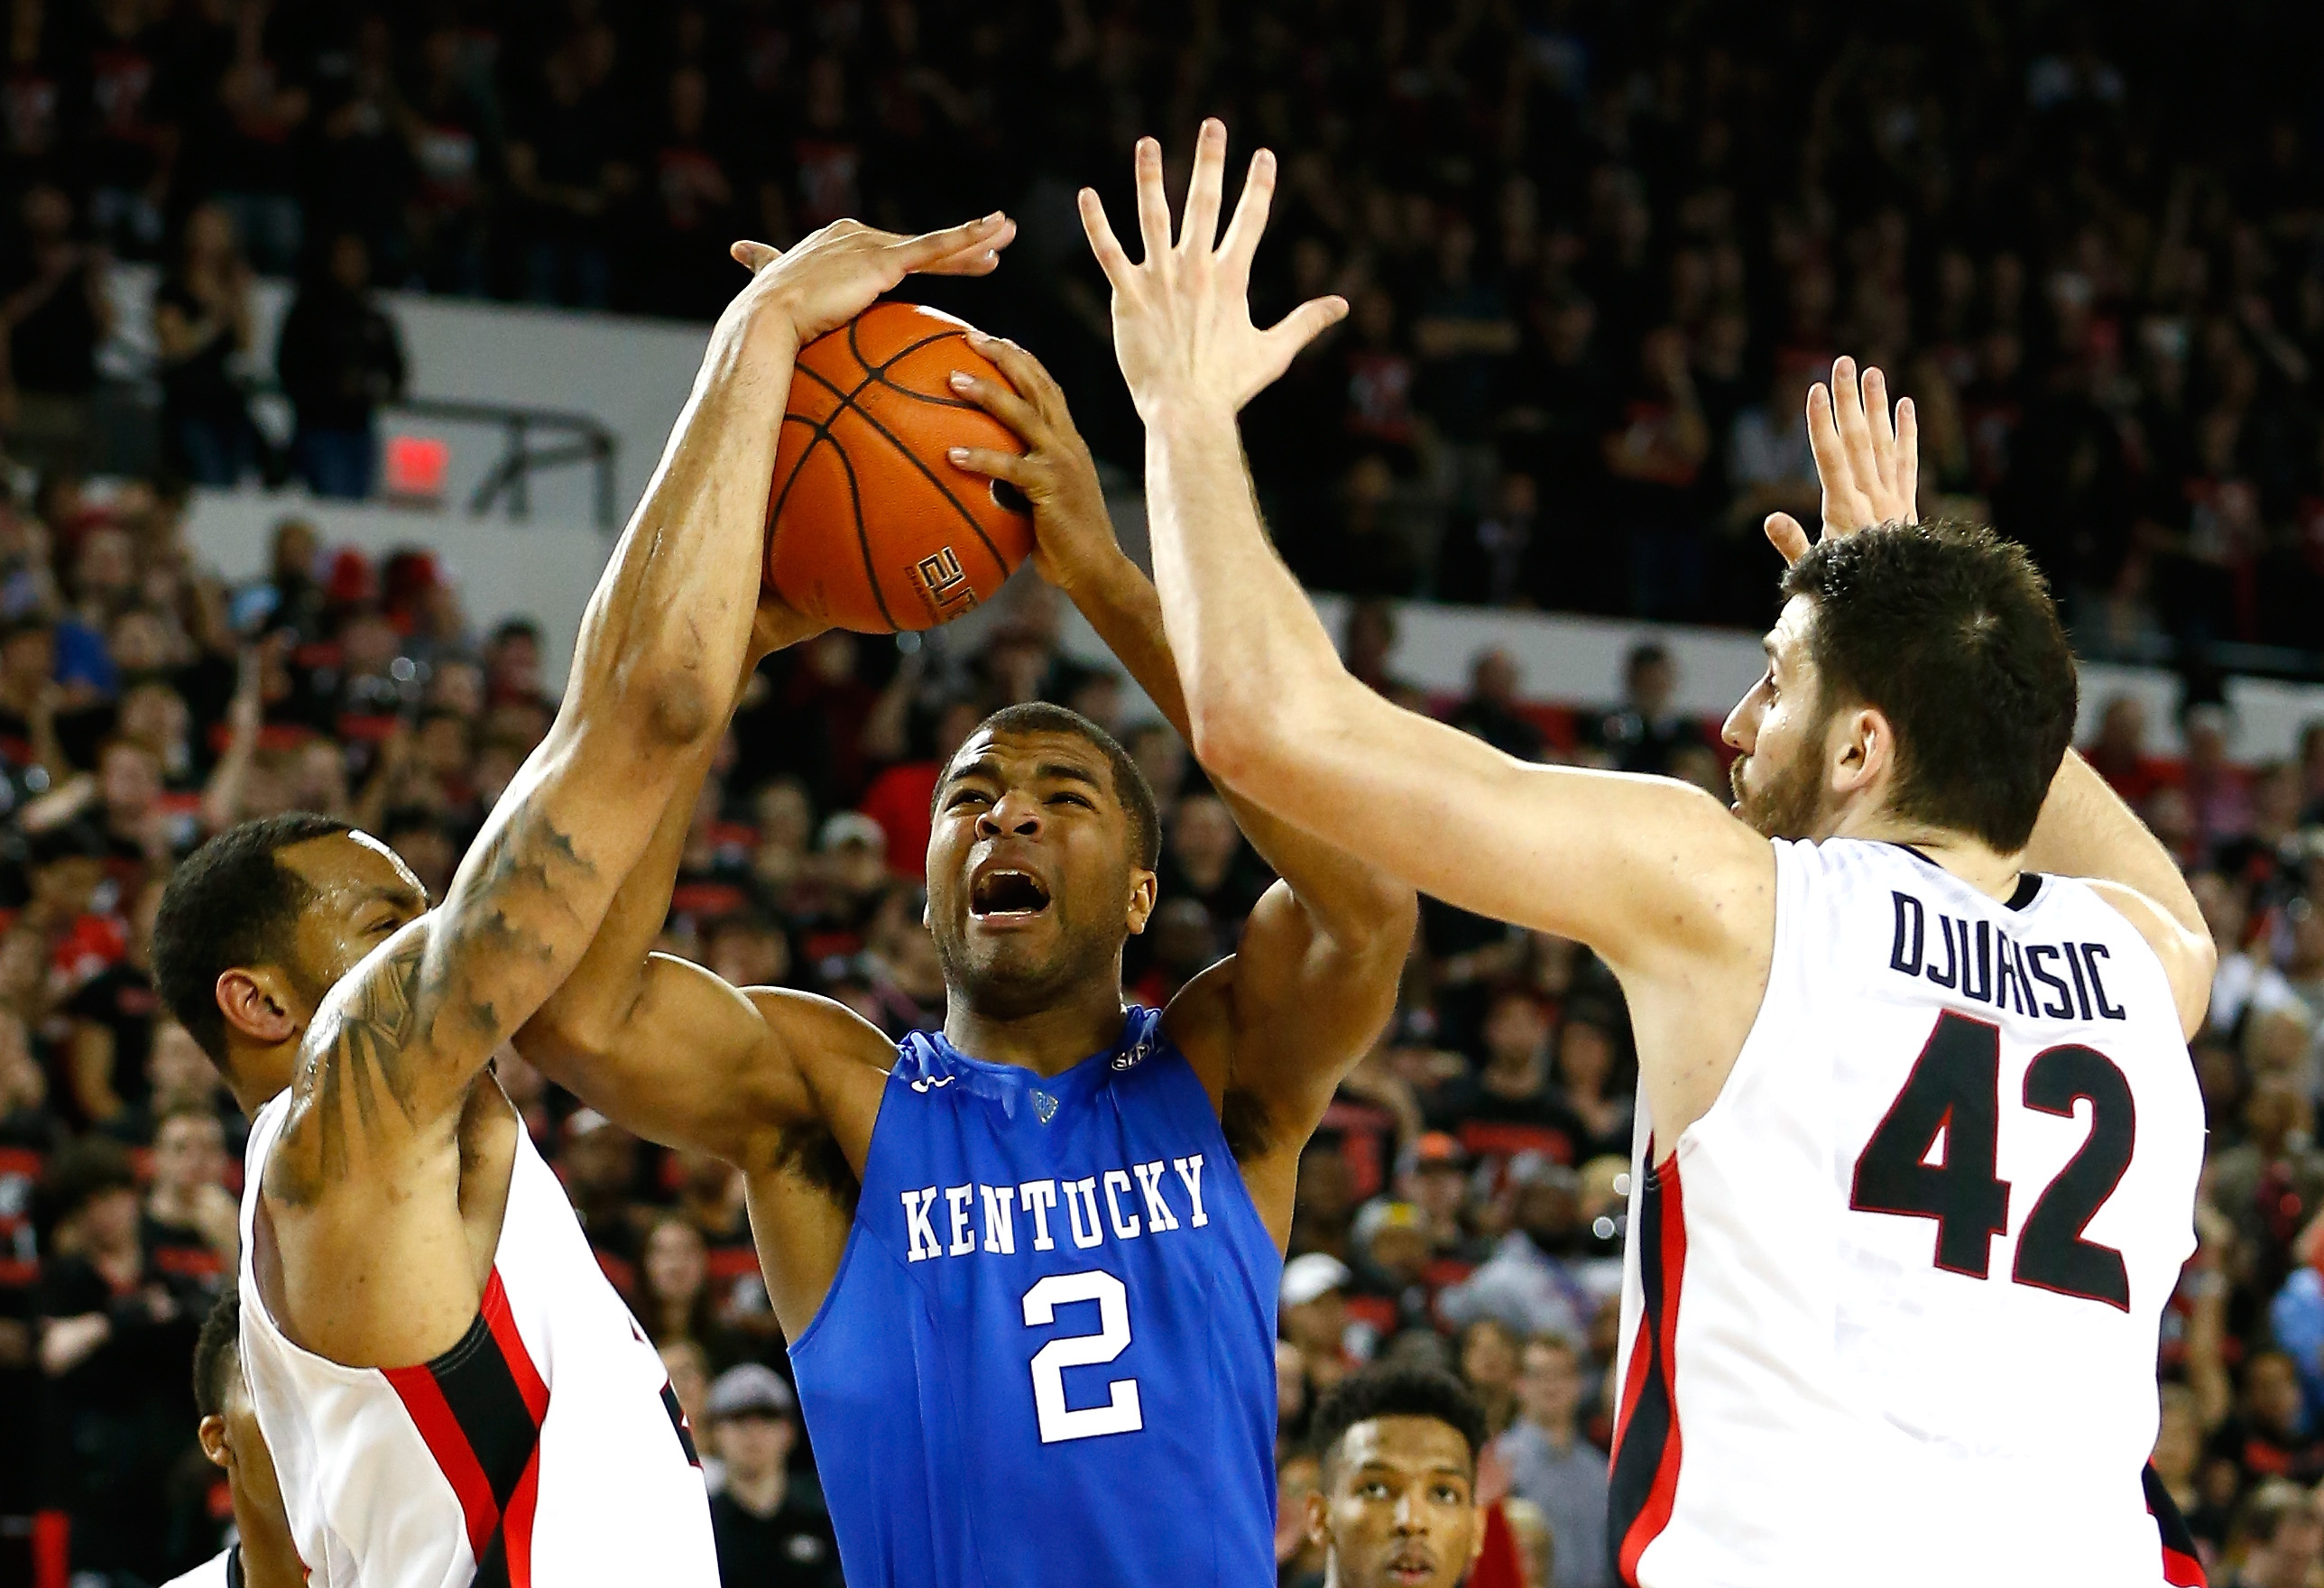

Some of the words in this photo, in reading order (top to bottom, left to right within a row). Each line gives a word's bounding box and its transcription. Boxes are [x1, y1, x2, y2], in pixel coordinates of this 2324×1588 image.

[1889, 890, 2126, 1020] DJURISIC
[900, 1154, 1209, 1262] KENTUCKY
[1849, 1007, 2136, 1314] 42
[1022, 1269, 1144, 1444] 2
